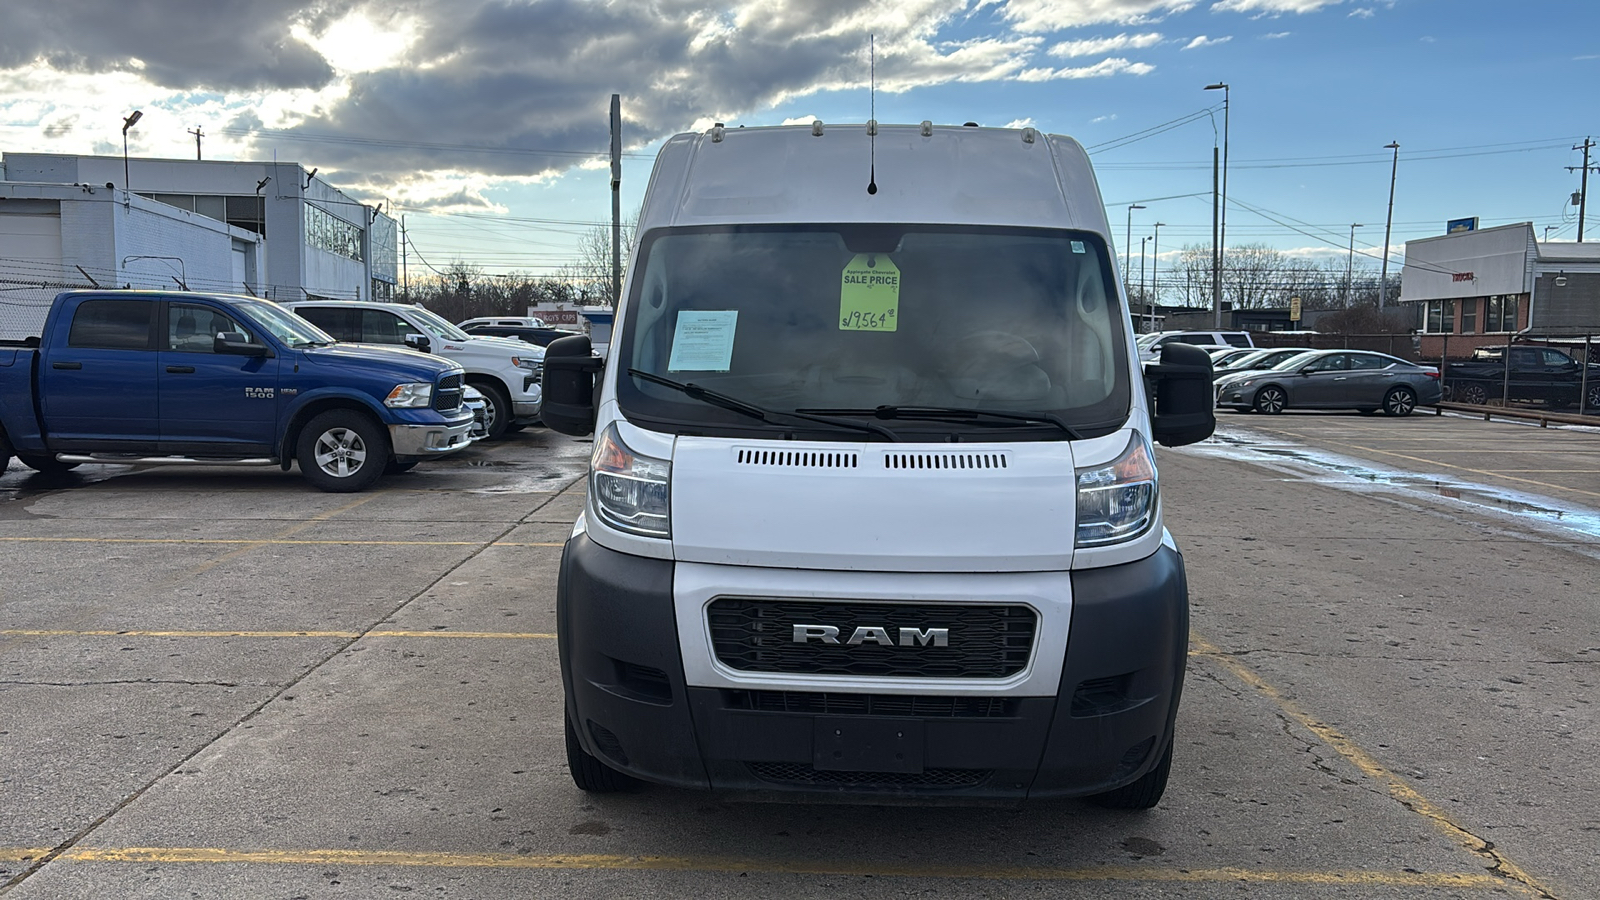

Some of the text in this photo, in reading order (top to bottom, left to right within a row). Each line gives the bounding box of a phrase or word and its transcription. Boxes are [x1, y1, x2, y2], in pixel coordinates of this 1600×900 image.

[844, 275, 898, 285] SALE PRICE
[842, 311, 886, 329] $19,564
[793, 624, 949, 647] RAM
